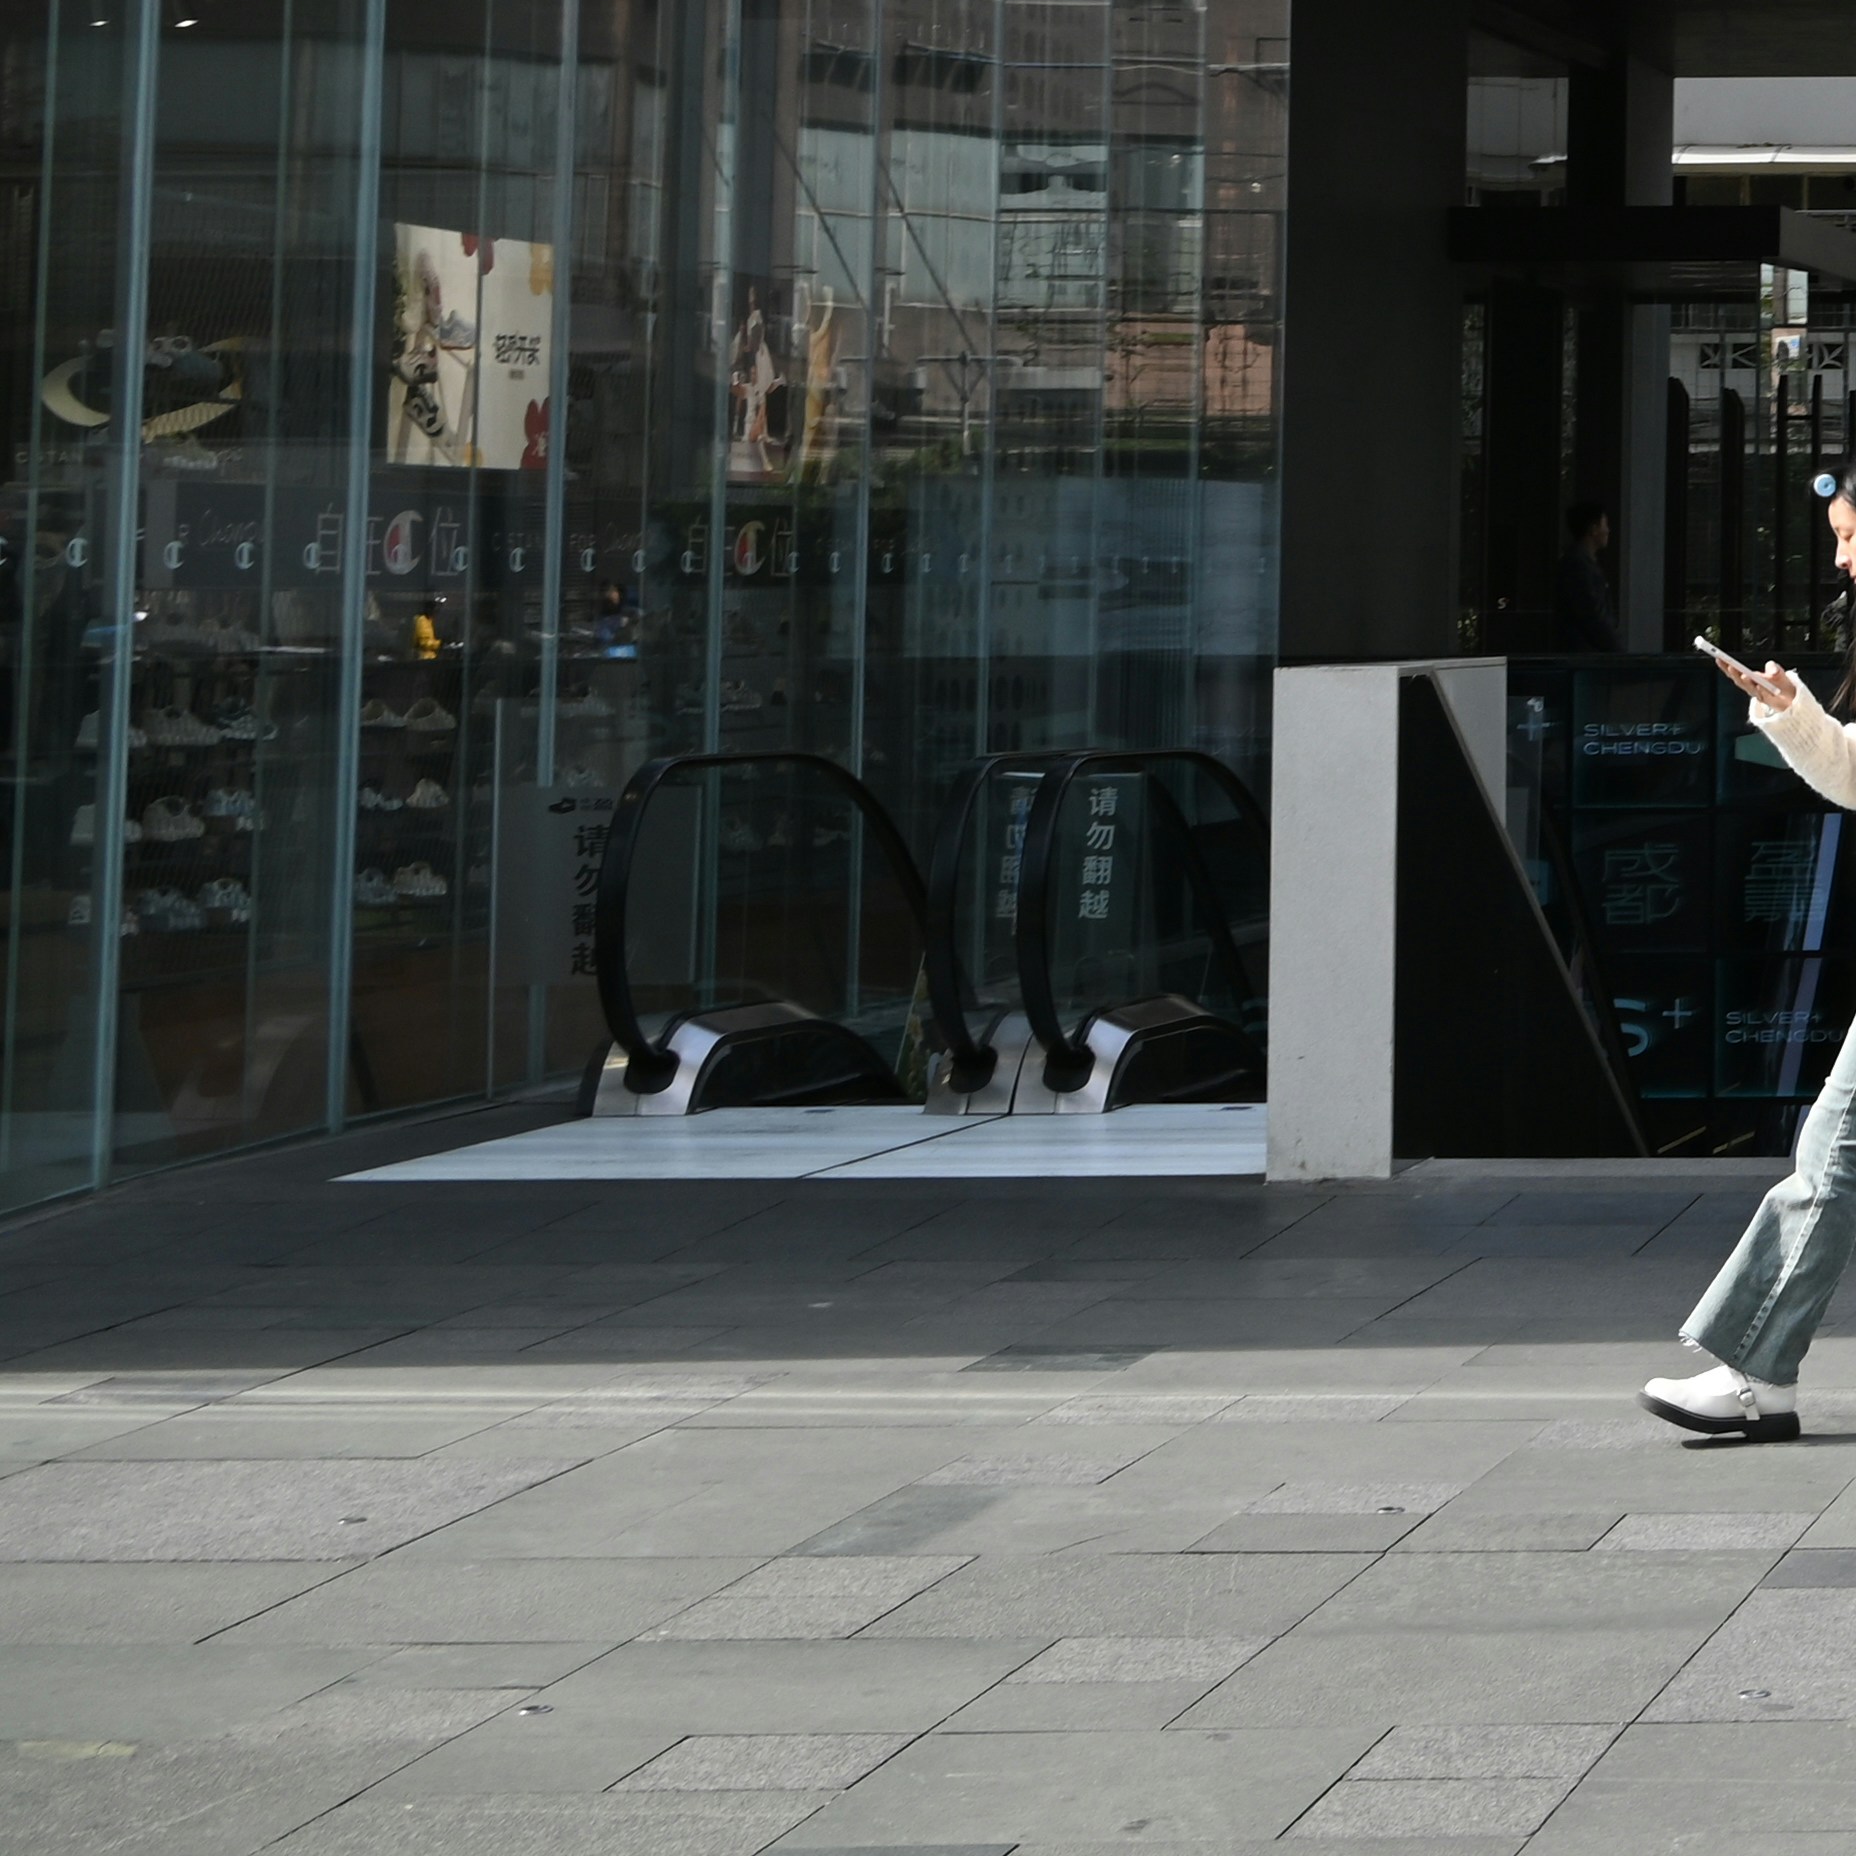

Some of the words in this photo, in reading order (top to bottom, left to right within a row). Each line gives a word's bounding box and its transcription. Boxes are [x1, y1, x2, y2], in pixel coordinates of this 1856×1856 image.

[1583, 722, 1684, 737] SILVER+
[1583, 741, 1702, 756] CHENGDU
[1077, 786, 1118, 919] 请勿翻越
[1601, 841, 1680, 925] 成都
[1725, 1011, 1822, 1025] SILVER+
[1725, 1030, 1843, 1044] CHENGDU
